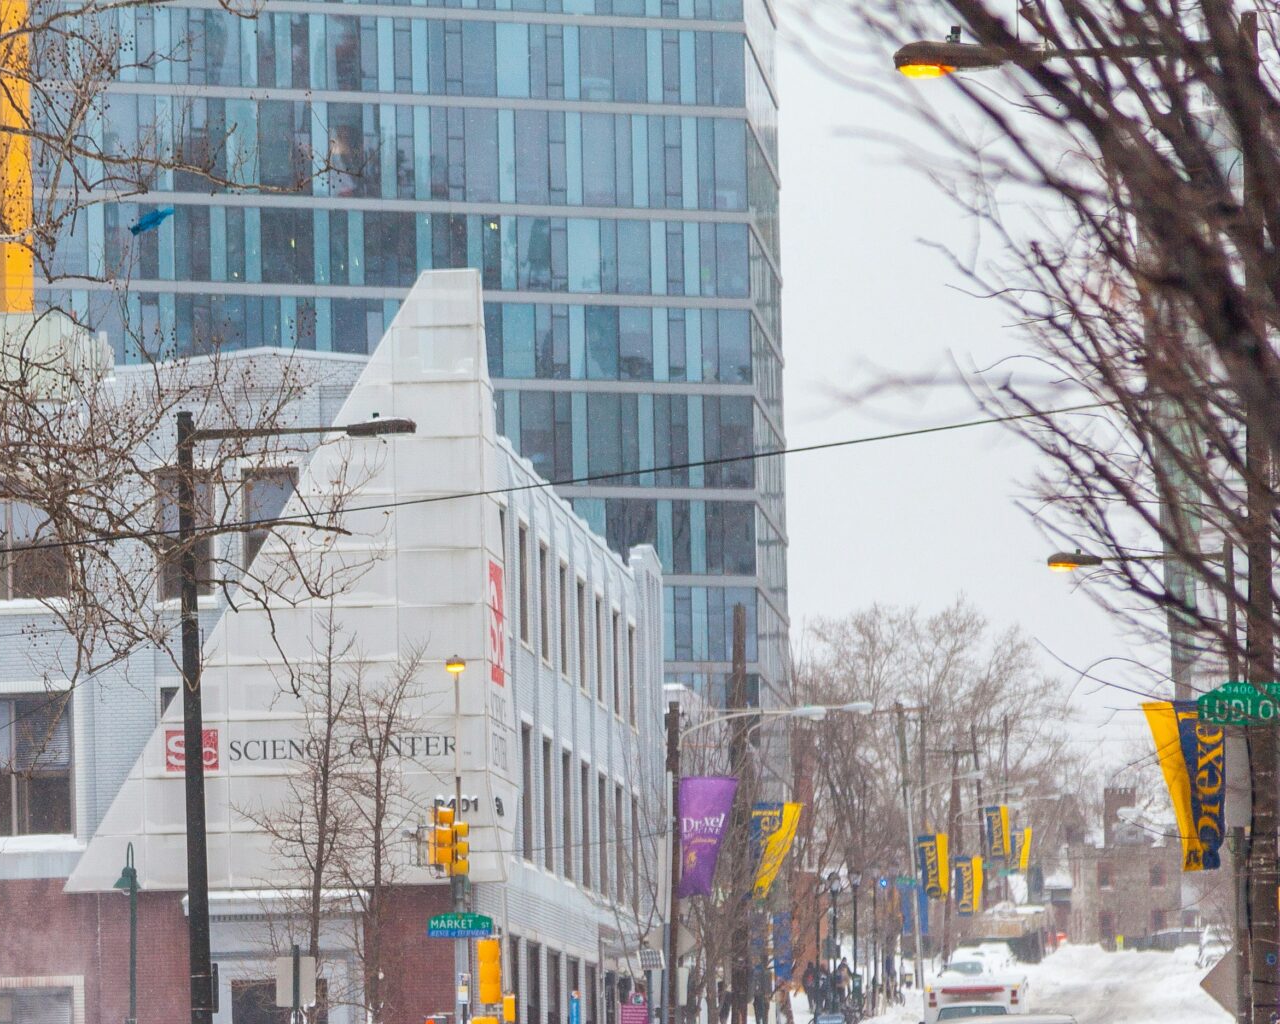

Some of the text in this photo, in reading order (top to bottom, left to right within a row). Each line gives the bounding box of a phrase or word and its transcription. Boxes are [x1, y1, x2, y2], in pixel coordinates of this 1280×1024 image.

[1203, 698, 1280, 721] LUDLO
[229, 738, 338, 761] SCIENCE
[349, 735, 457, 758] CENTER
[682, 812, 725, 833] Drxel
[430, 919, 473, 929] MARKET
